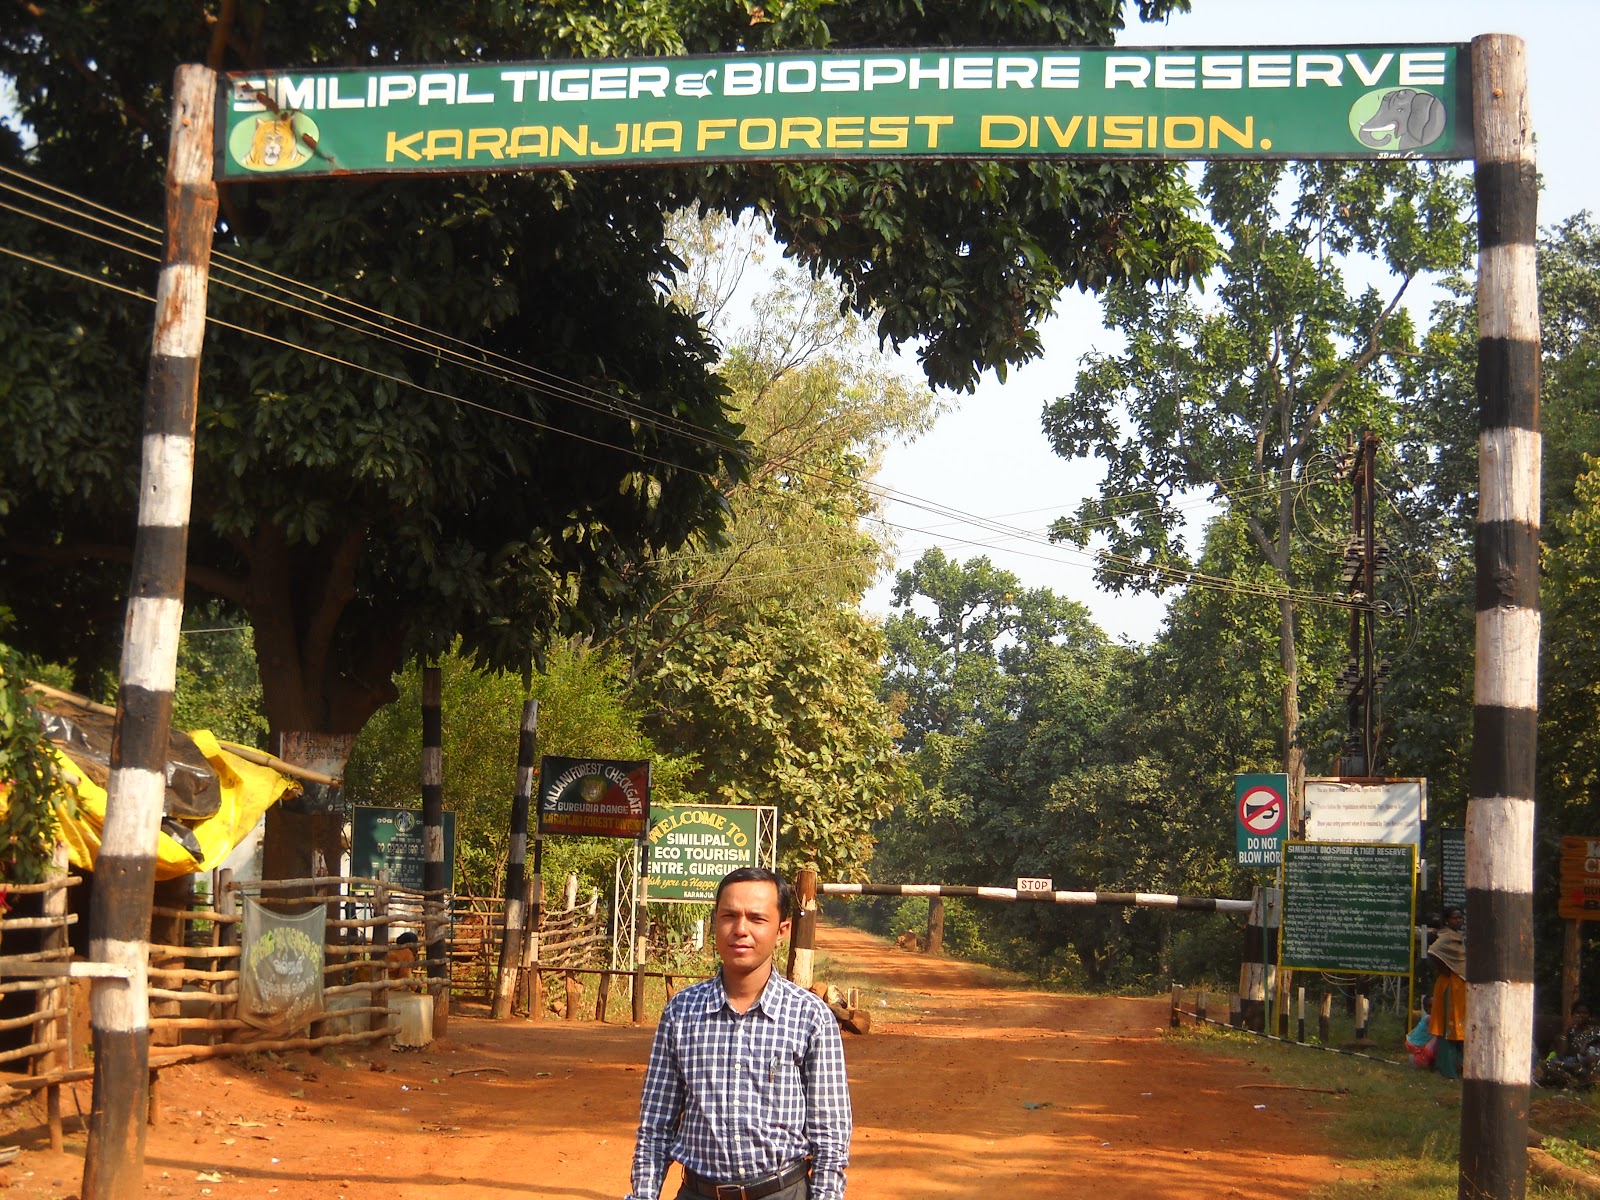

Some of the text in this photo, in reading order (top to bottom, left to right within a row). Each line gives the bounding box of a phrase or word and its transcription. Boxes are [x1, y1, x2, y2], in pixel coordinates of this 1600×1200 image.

[233, 53, 1446, 112] SIMILIPAL TIGER & BIOSPHERE RESERVE
[385, 115, 1272, 162] KARANJIA FOREST DIVISION.
[569, 763, 604, 780] FOREST
[557, 802, 629, 815] GURGURIA RANGE
[583, 815, 615, 829] FOREST
[649, 811, 748, 847] WELCOME TO
[667, 833, 729, 846] SIMILIPAL
[1247, 838, 1278, 850] DO NOT
[654, 847, 681, 860] ECO
[684, 847, 751, 862] TOURISM
[1238, 851, 1262, 864] BLOW
[1377, 848, 1407, 856] RESERVE
[689, 862, 750, 875] GURGU
[660, 879, 680, 889] you
[689, 877, 719, 891] Happy
[1021, 880, 1048, 890] STOP
[683, 891, 715, 899] KARANJIA
